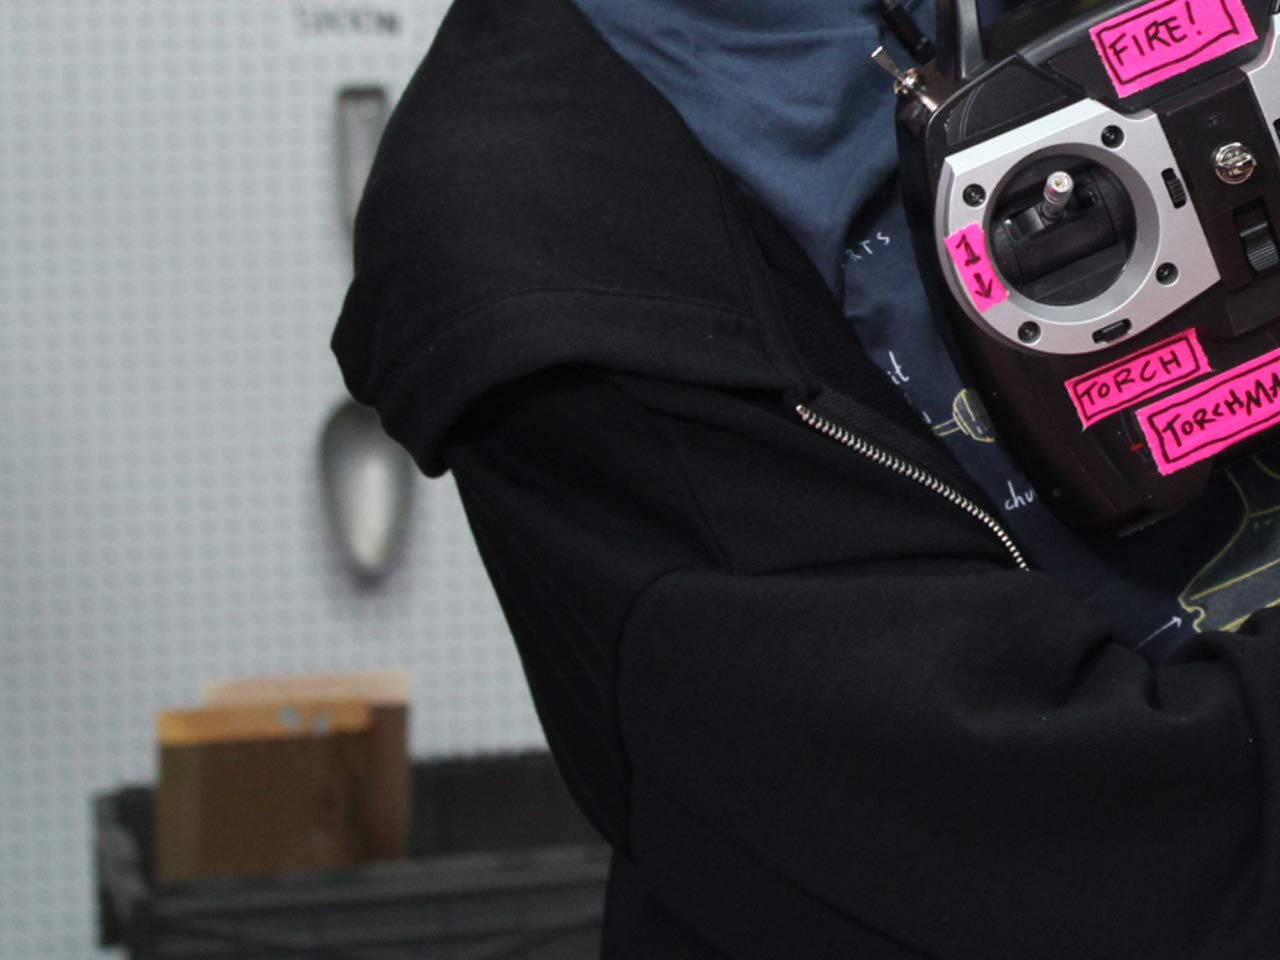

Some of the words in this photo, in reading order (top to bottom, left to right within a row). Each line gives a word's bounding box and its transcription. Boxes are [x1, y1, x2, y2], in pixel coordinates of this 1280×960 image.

[1108, 0, 1203, 67] FIRE!
[843, 231, 890, 263] RTS
[955, 234, 981, 267] 1
[1079, 351, 1181, 407] TORCH
